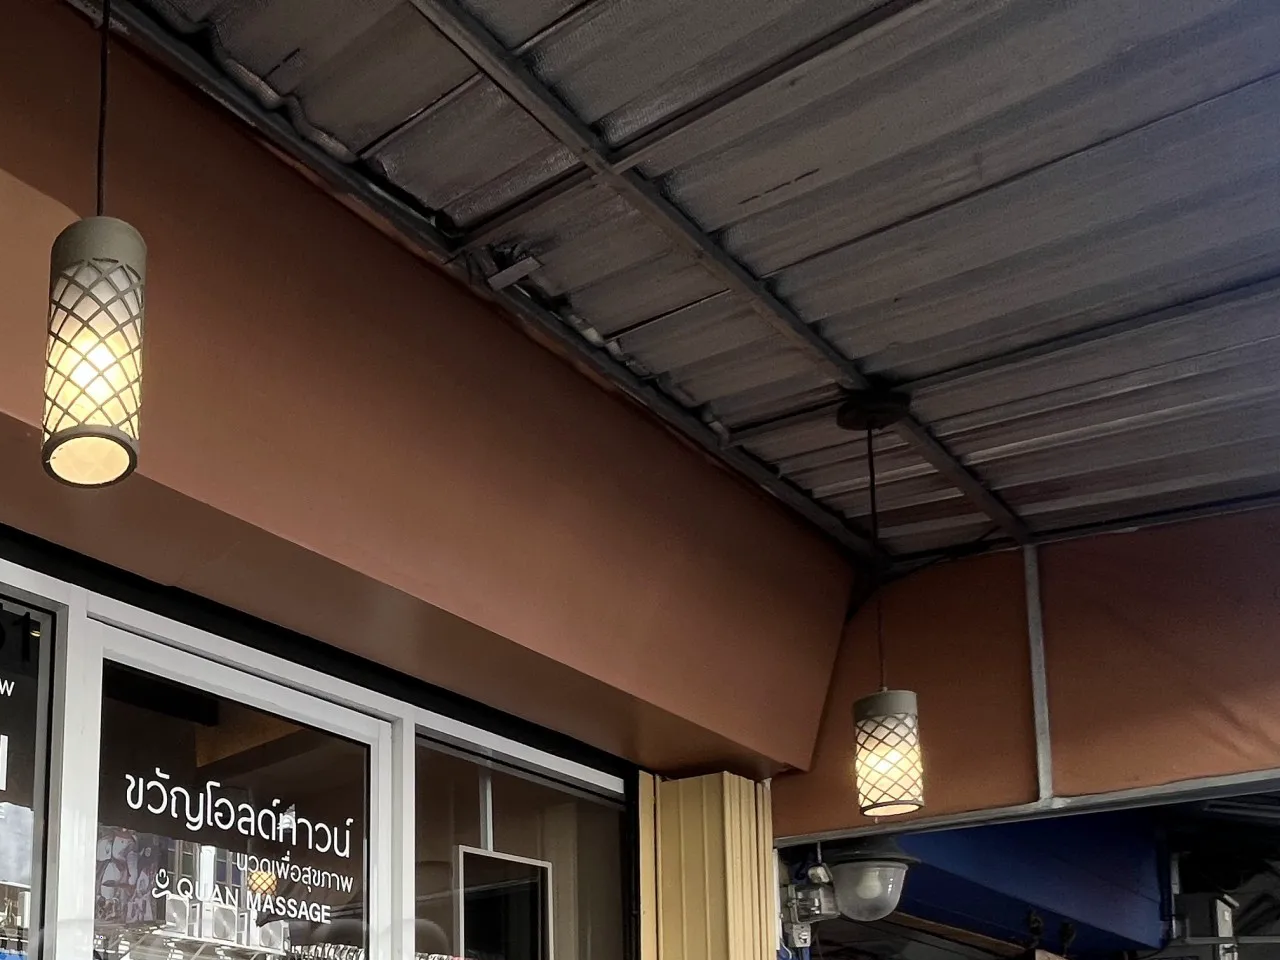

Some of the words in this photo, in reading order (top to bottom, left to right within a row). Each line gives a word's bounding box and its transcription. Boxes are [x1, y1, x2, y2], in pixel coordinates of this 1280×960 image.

[125, 767, 354, 858] ขวัญโอลด์ทาวน์
[236, 850, 354, 894] นวดเพื่อสุขภาพ
[176, 878, 239, 907] QUAN
[247, 894, 332, 925] MASSAGE
